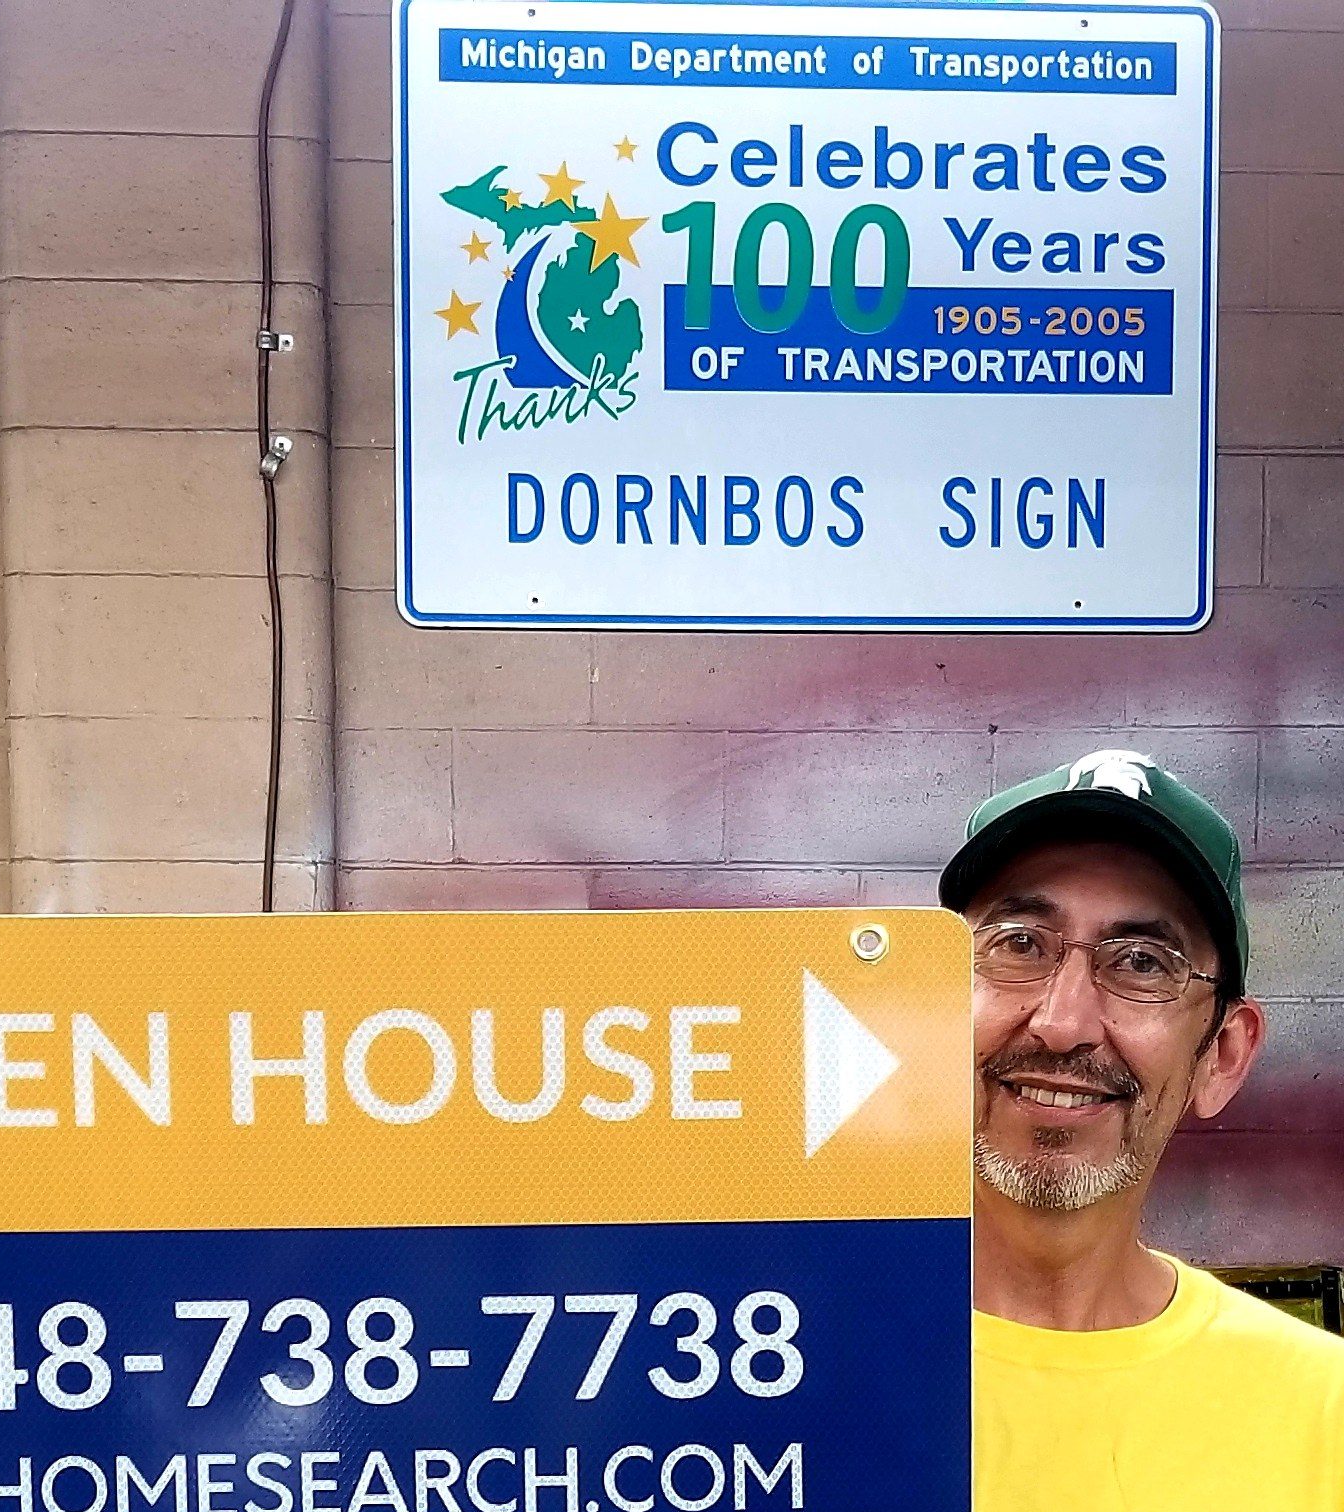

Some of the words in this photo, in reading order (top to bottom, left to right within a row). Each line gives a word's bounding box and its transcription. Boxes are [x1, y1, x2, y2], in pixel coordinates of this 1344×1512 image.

[459, 37, 607, 80] Michigan
[629, 41, 827, 82] Department
[853, 44, 884, 73] of
[910, 47, 1154, 86] Transportation
[657, 121, 1169, 195] Celebrates
[661, 200, 912, 335] 100
[943, 217, 1168, 274] Years
[933, 305, 1147, 336] 1905-2005
[453, 352, 641, 446] Thanks
[691, 346, 737, 382] OF
[782, 346, 1145, 383] TRANSPORTATION
[507, 472, 865, 548] DORNBOS
[939, 475, 1106, 550] SIGN
[228, 1005, 740, 1125] HOUSE
